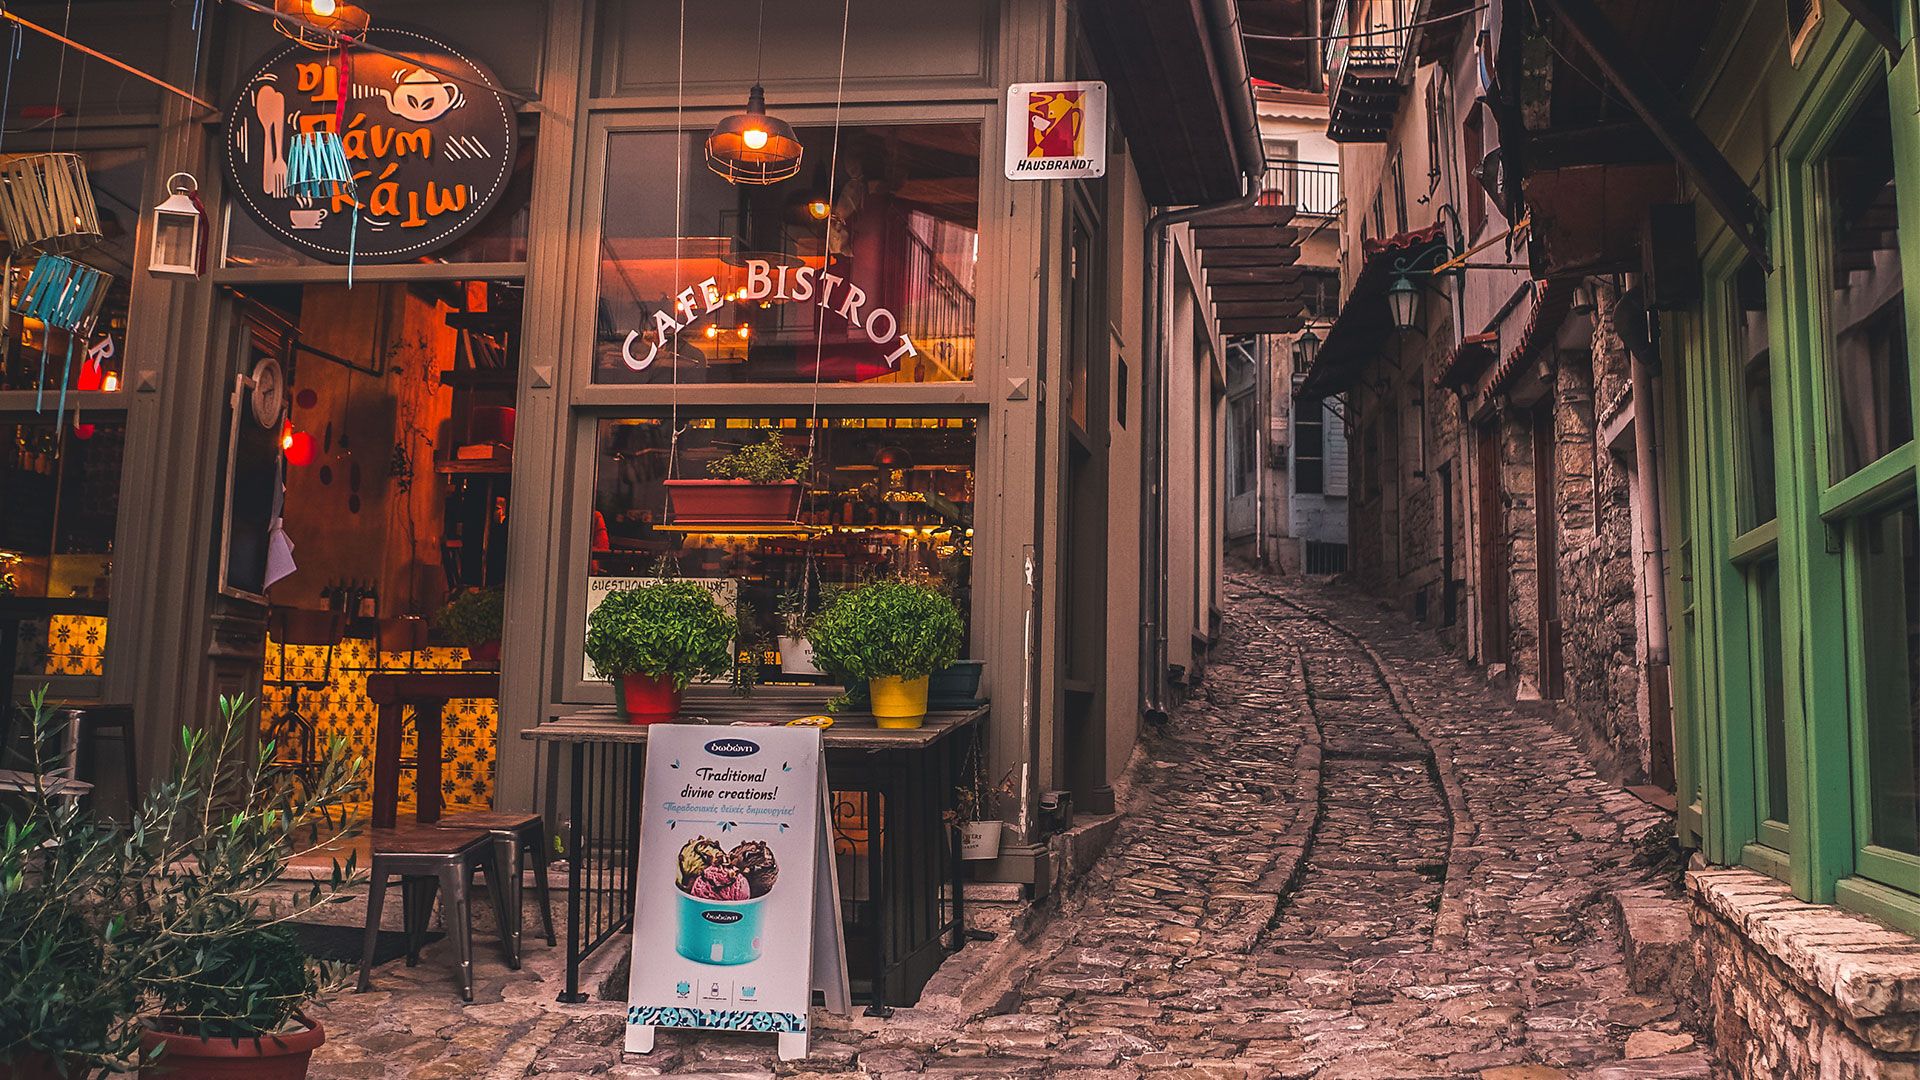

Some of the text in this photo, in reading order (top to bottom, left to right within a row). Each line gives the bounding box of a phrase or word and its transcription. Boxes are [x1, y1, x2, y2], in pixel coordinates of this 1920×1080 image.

[1016, 159, 1094, 171] HAUSBRANDT
[622, 259, 918, 371] CAFE BISTROT
[695, 767, 767, 783] Traditional
[680, 783, 779, 801] divine creations!
